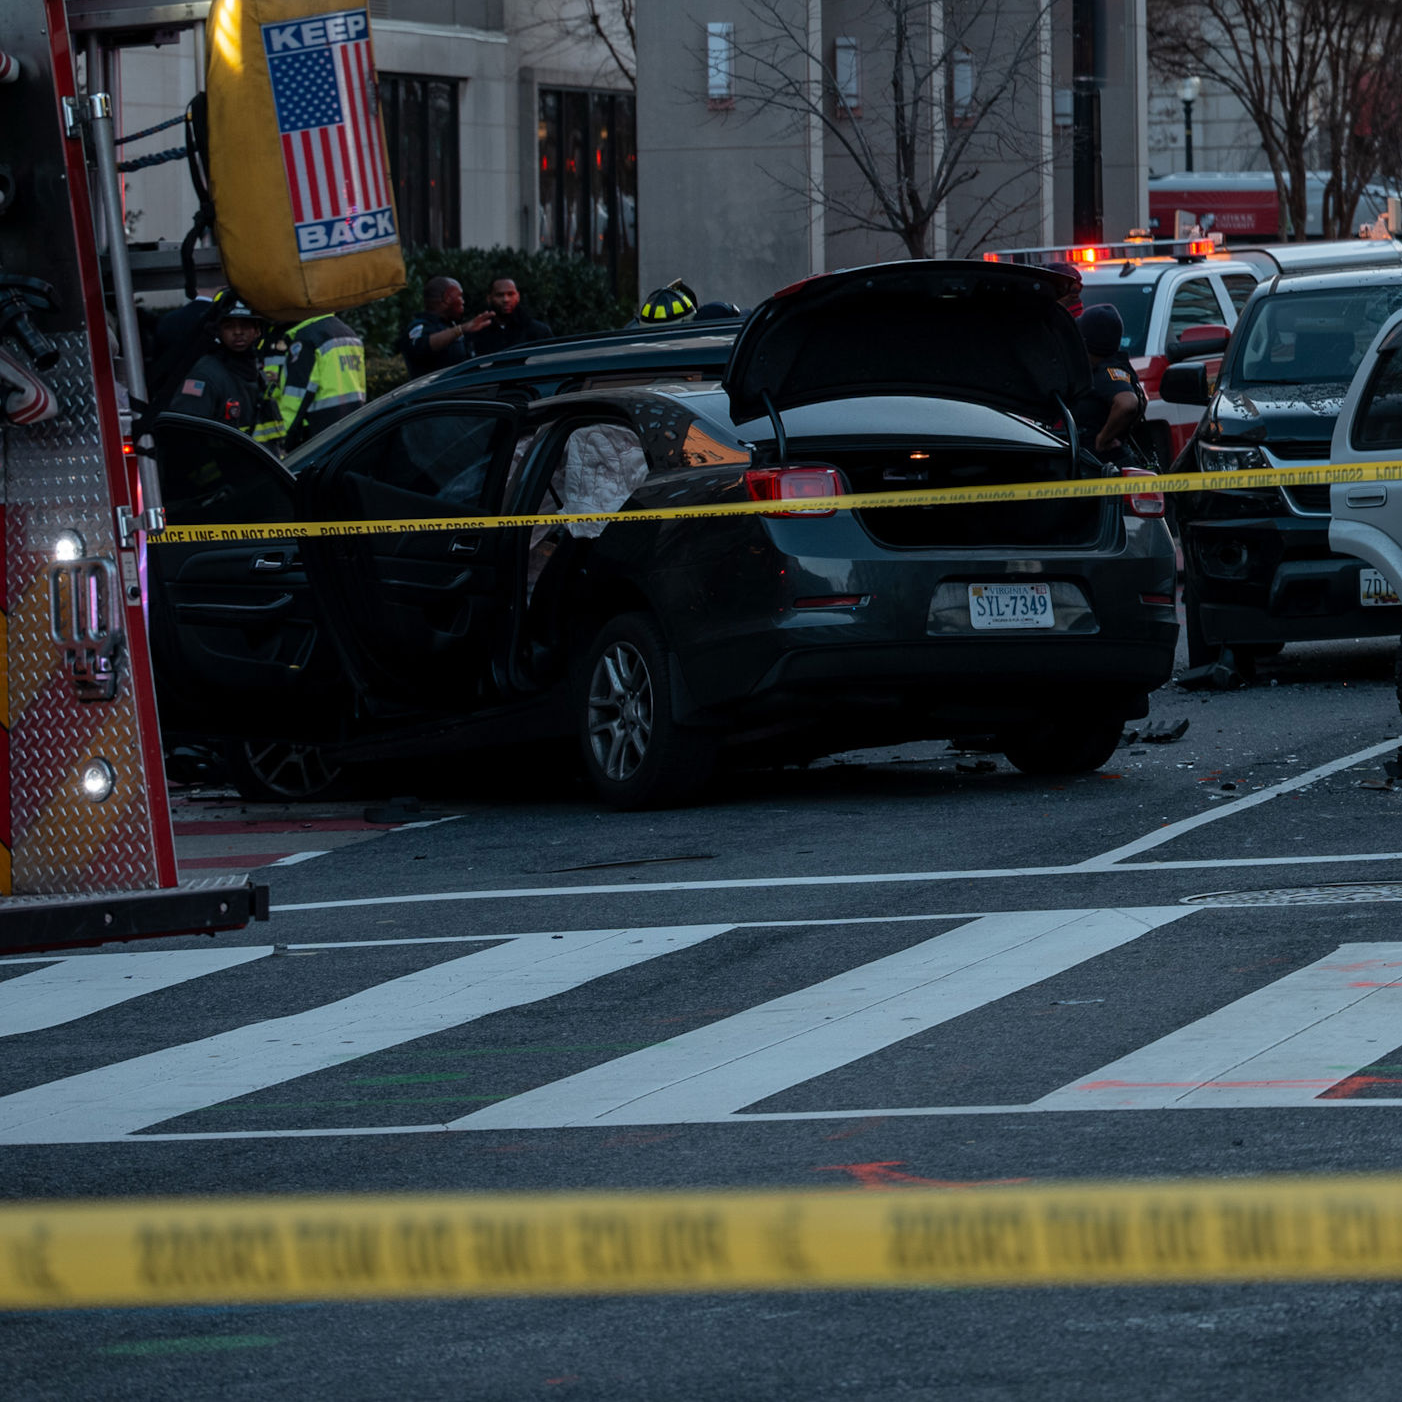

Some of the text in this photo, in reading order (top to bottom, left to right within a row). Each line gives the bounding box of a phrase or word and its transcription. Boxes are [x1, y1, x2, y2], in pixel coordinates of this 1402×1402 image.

[269, 14, 366, 52] KEEP
[298, 210, 395, 251] BACK
[989, 586, 1029, 595] VIRGINIA
[976, 595, 1047, 617] SYL-7349
